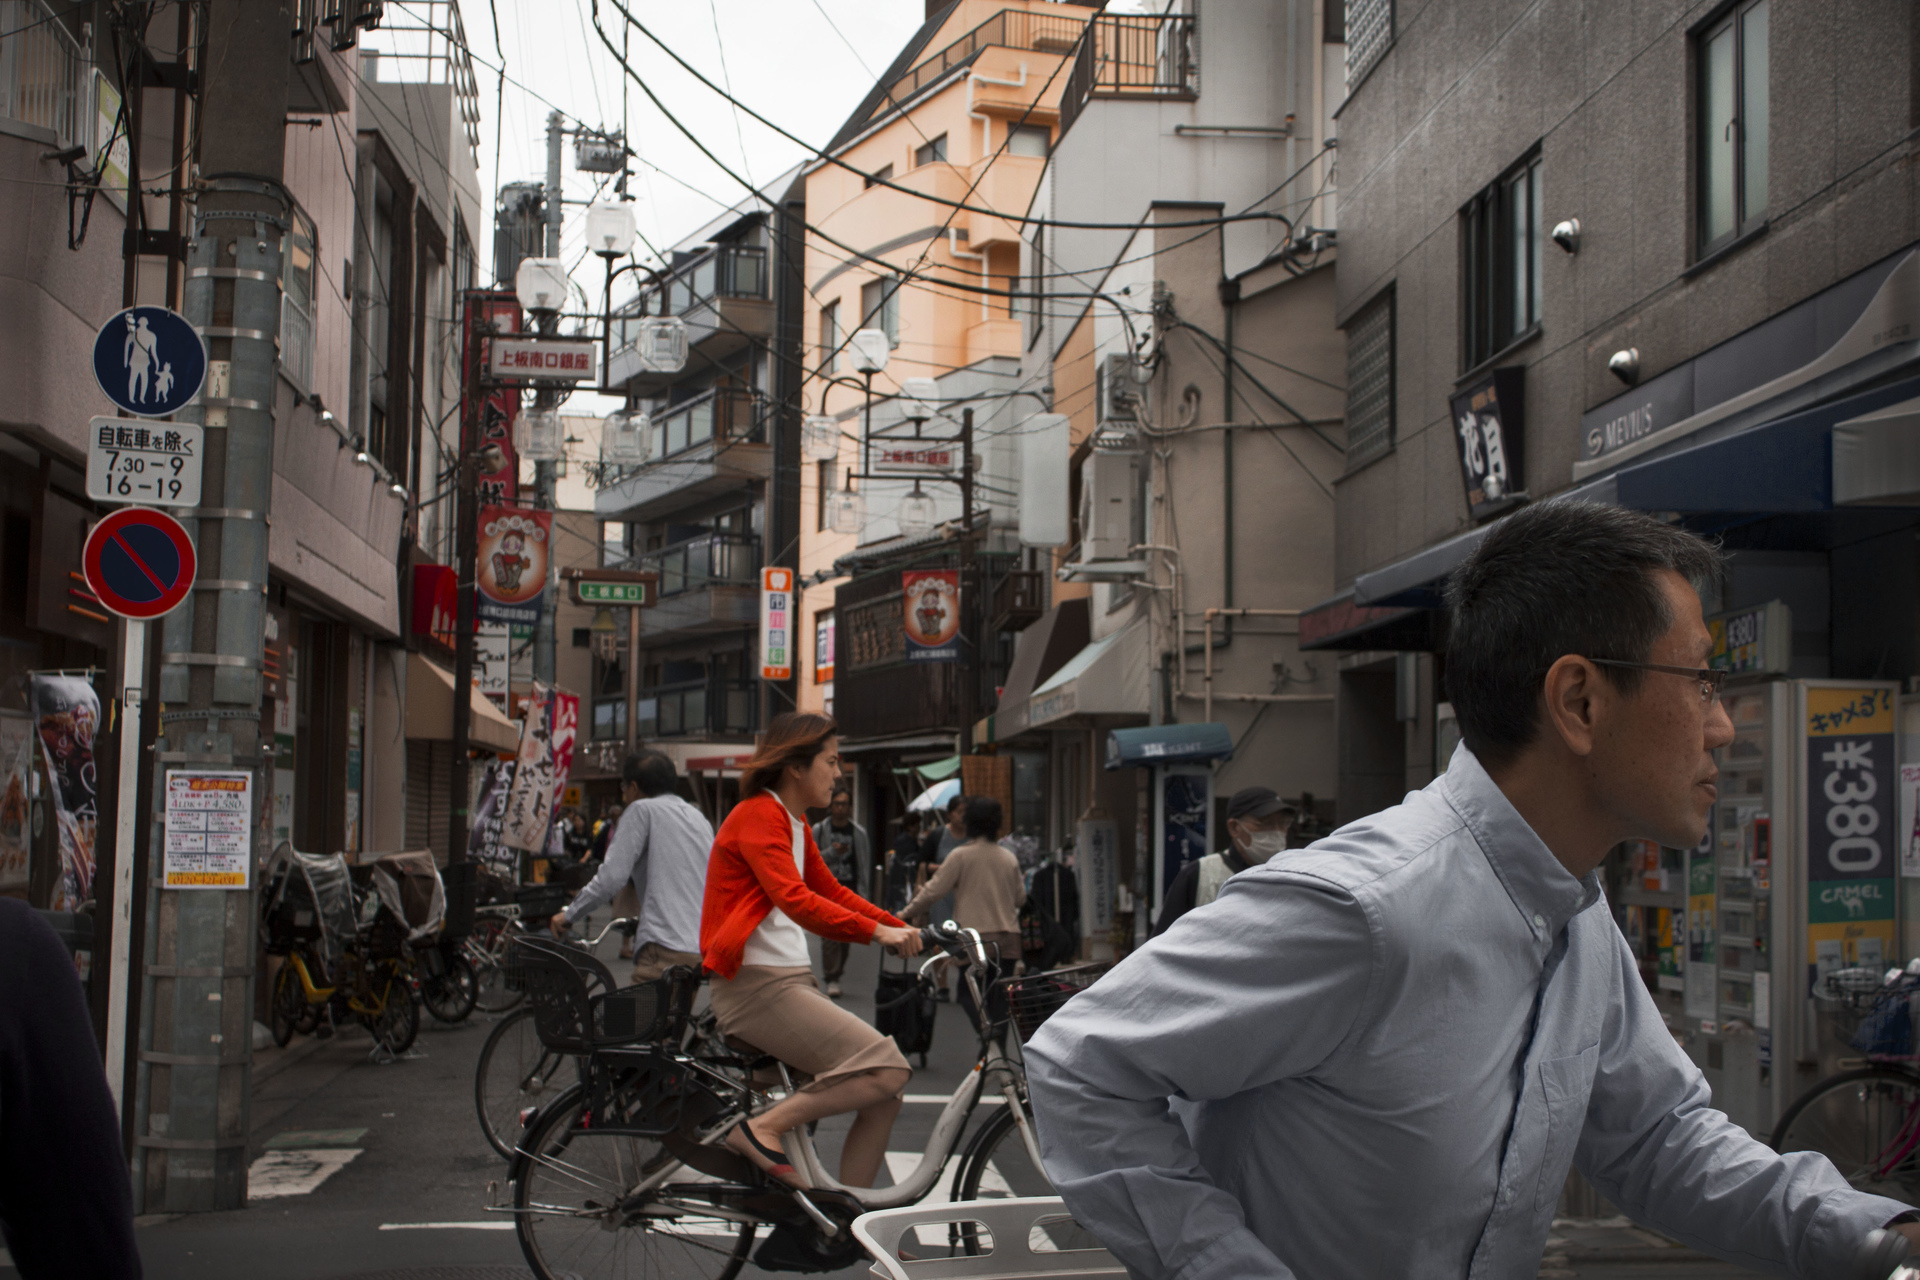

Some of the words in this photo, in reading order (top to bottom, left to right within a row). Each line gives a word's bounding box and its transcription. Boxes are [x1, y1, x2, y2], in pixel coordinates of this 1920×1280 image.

[498, 349, 590, 371] 上板南口銀座
[1605, 402, 1653, 447] MEVIUS
[98, 425, 194, 453] 自転車を除く
[105, 474, 183, 499] 16-19
[584, 585, 639, 600] 上板南口
[768, 593, 786, 665] 市川歯科
[1821, 740, 1882, 873] ¥380
[1820, 884, 1883, 905] CAMEL
